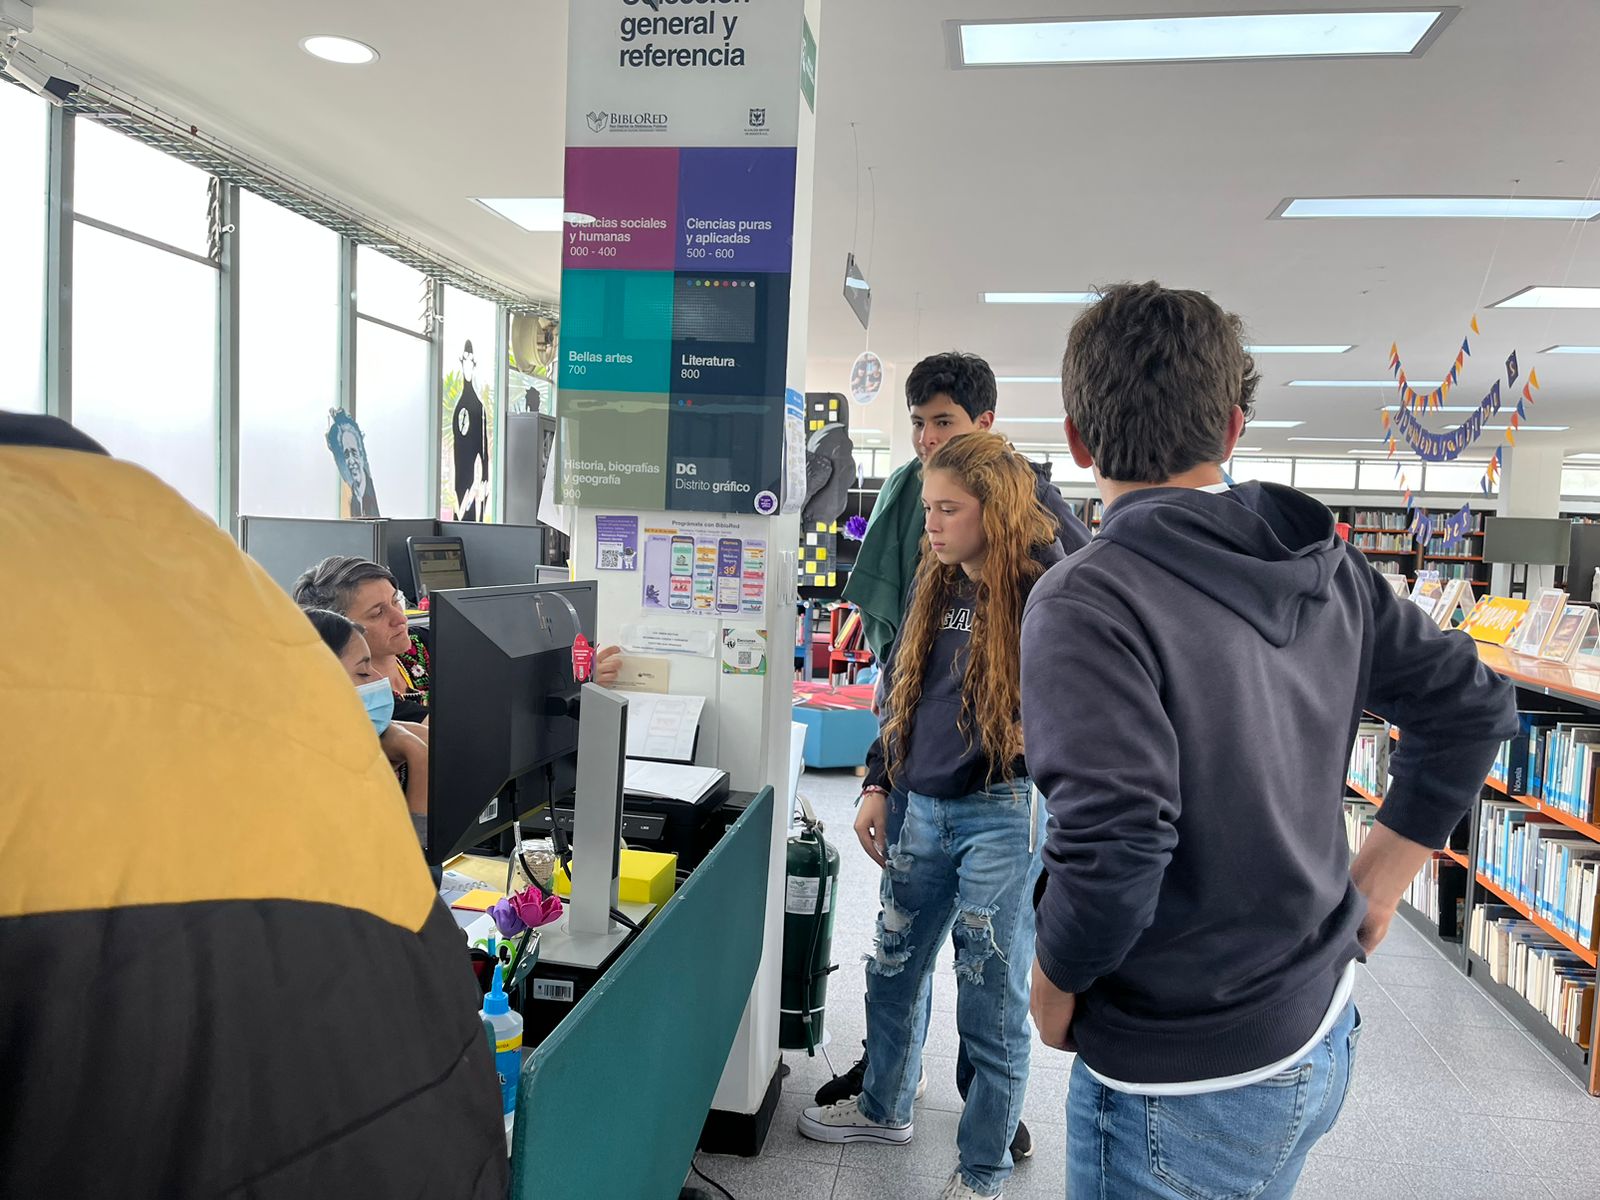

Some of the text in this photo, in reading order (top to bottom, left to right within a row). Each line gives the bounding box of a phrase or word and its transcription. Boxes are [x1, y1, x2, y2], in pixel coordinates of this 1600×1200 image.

[620, 11, 738, 42] general y
[620, 42, 745, 67] referencia
[620, 218, 667, 228] sociales
[686, 218, 772, 232] Ciencias puras
[569, 231, 631, 244] y humanas
[686, 232, 751, 246] y aplicadas
[570, 246, 589, 256] 000
[598, 246, 617, 257] 400
[686, 248, 706, 258] 500
[715, 248, 735, 259] 600
[568, 350, 633, 364] Bellas artes
[681, 354, 735, 368] Literatura
[568, 364, 587, 375] 700
[680, 369, 700, 379] 800
[564, 459, 607, 472] Historia,
[675, 463, 697, 475] DG
[563, 474, 621, 486] y geografía
[675, 478, 751, 494] Distrito gráfico
[563, 488, 581, 499] 900
[1513, 767, 1522, 791] Novela
